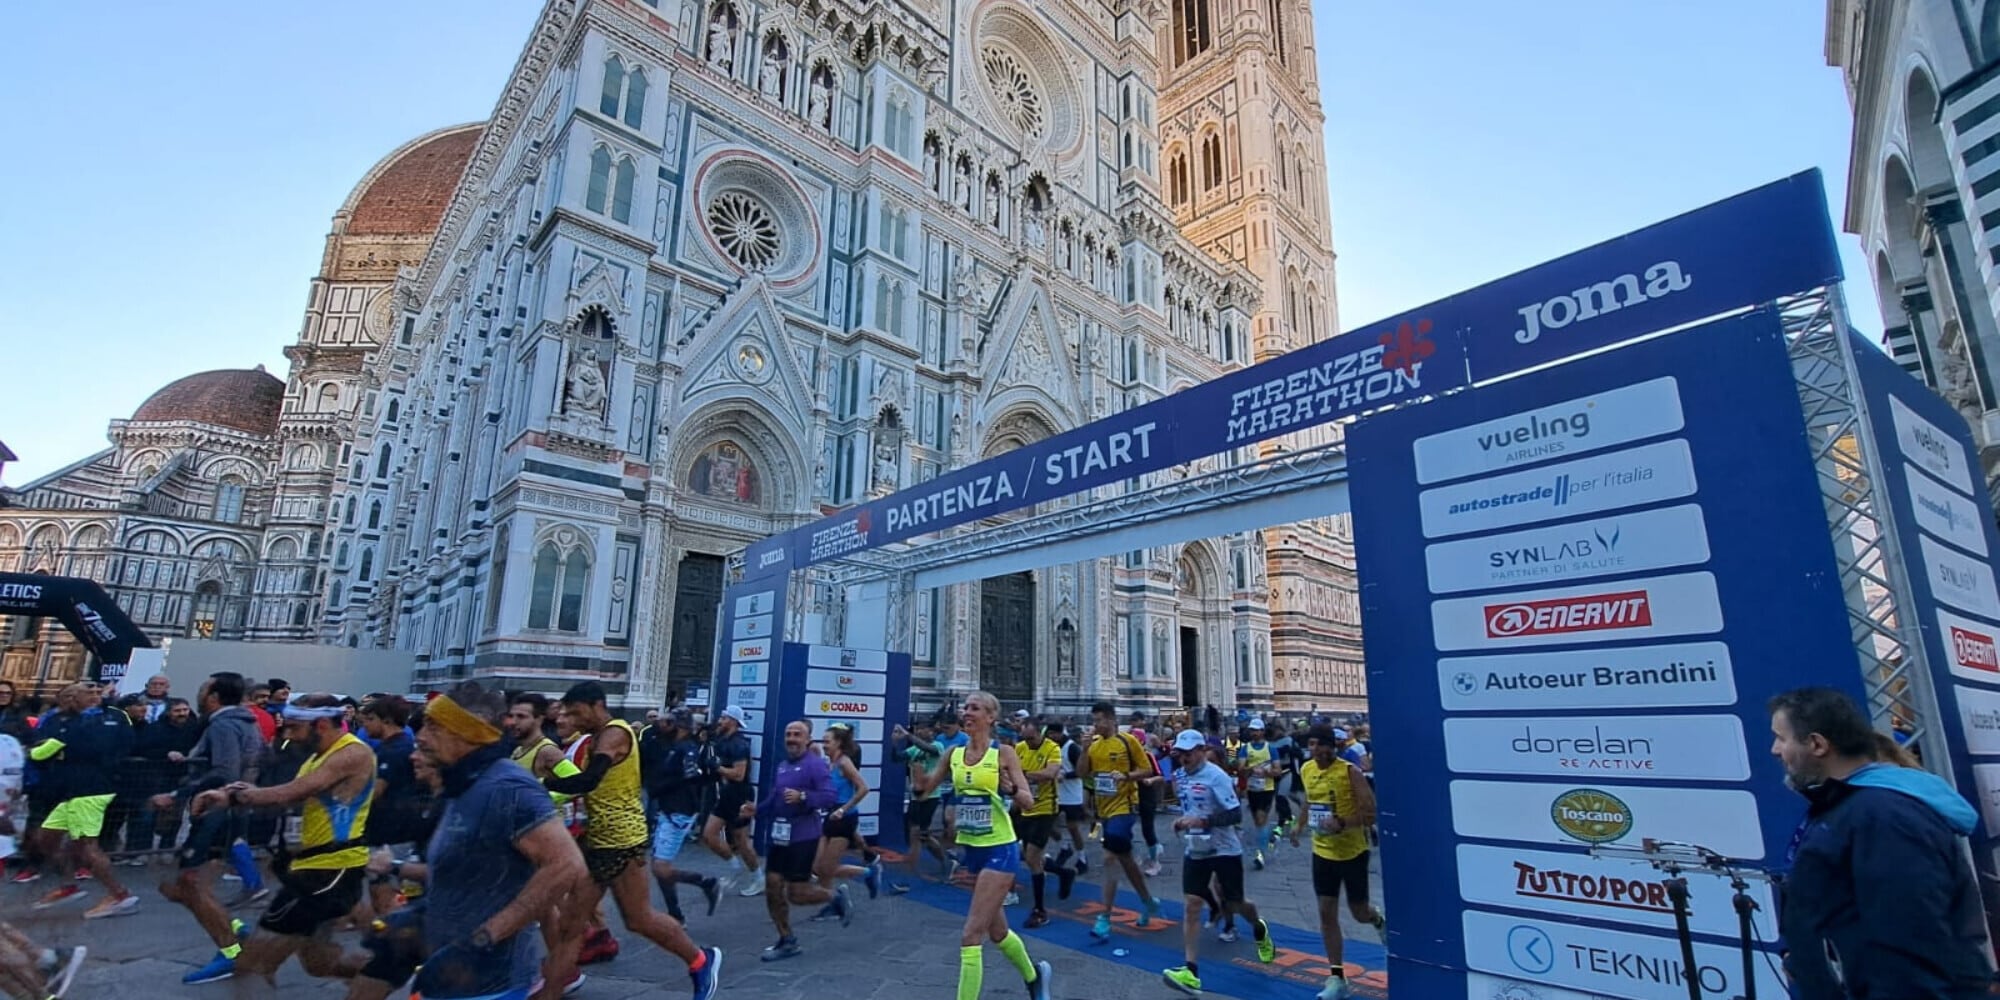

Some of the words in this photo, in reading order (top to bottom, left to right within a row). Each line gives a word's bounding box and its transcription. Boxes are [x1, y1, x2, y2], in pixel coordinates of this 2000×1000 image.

[1230, 344, 1386, 416] FIRENZE
[1226, 362, 1423, 442] MARATHON
[1476, 411, 1590, 452] vueling
[1505, 441, 1566, 464] AIRLINES
[886, 470, 1014, 533] PARTENZA
[1046, 422, 1157, 486] START
[1448, 485, 1553, 515] autostrade
[1569, 477, 1599, 497] per
[810, 531, 869, 561] MARATHON
[812, 519, 859, 547] FIRENZE
[1490, 539, 1593, 568] SYNLAB
[1490, 566, 1549, 580] PARTNER
[1554, 564, 1567, 574] DI
[1572, 556, 1625, 571] SALUTE
[1532, 597, 1646, 630] ENERVIT
[1484, 671, 1587, 691] Autoeur
[1593, 660, 1717, 687] Brandini
[831, 702, 868, 712] CONAD
[1511, 725, 1651, 755] dorelan
[1560, 806, 1624, 823] Toscano
[1513, 860, 1688, 909] TUTTOSPOR
